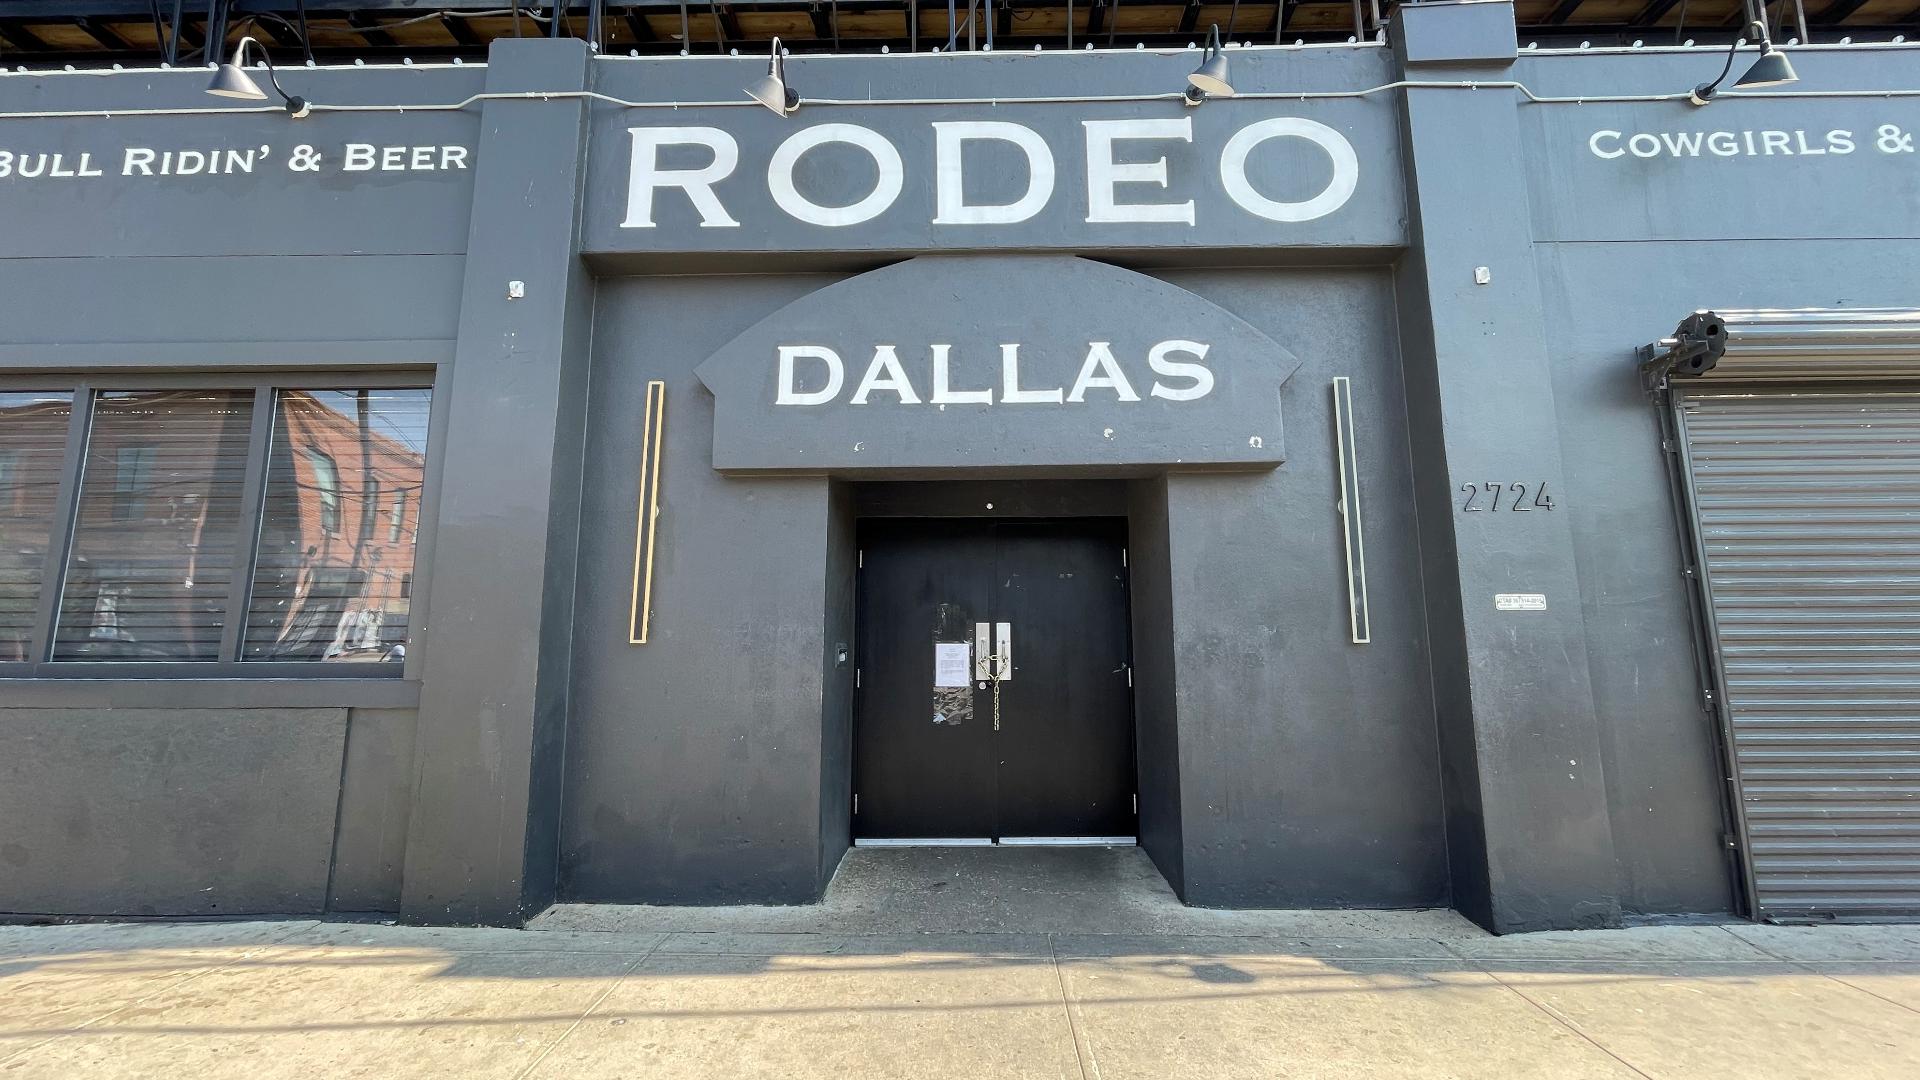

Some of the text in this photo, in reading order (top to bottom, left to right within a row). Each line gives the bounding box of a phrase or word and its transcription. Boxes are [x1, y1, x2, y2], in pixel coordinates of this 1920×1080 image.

[288, 144, 322, 172] &
[342, 143, 468, 171] BEER
[1588, 123, 1916, 160] COWGIRLS &
[619, 116, 1359, 228] RODEO
[775, 339, 1215, 406] DALLAS
[1461, 481, 1555, 512] 2724
